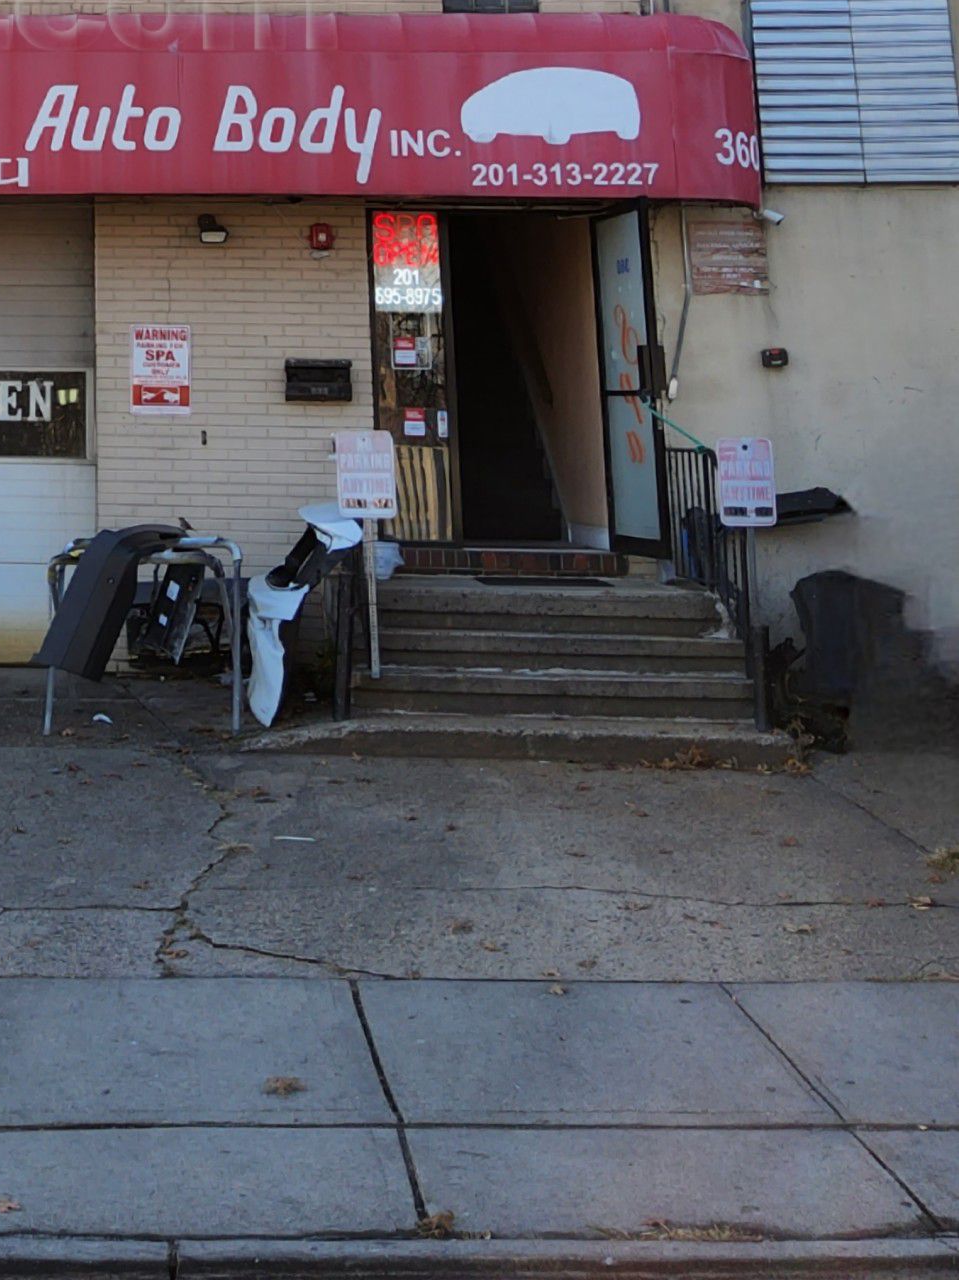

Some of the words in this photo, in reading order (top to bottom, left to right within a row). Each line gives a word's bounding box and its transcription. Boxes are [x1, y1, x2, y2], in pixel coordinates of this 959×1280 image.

[25, 84, 182, 152] Auto
[213, 84, 382, 184] Body
[390, 128, 462, 157] INC.
[714, 127, 760, 172] 360
[471, 162, 660, 187] 201-313-2227
[374, 212, 438, 241] SPA
[374, 240, 439, 267] OPEN
[393, 268, 420, 285] 201
[134, 328, 188, 341] WARNING
[145, 349, 176, 362] SPA
